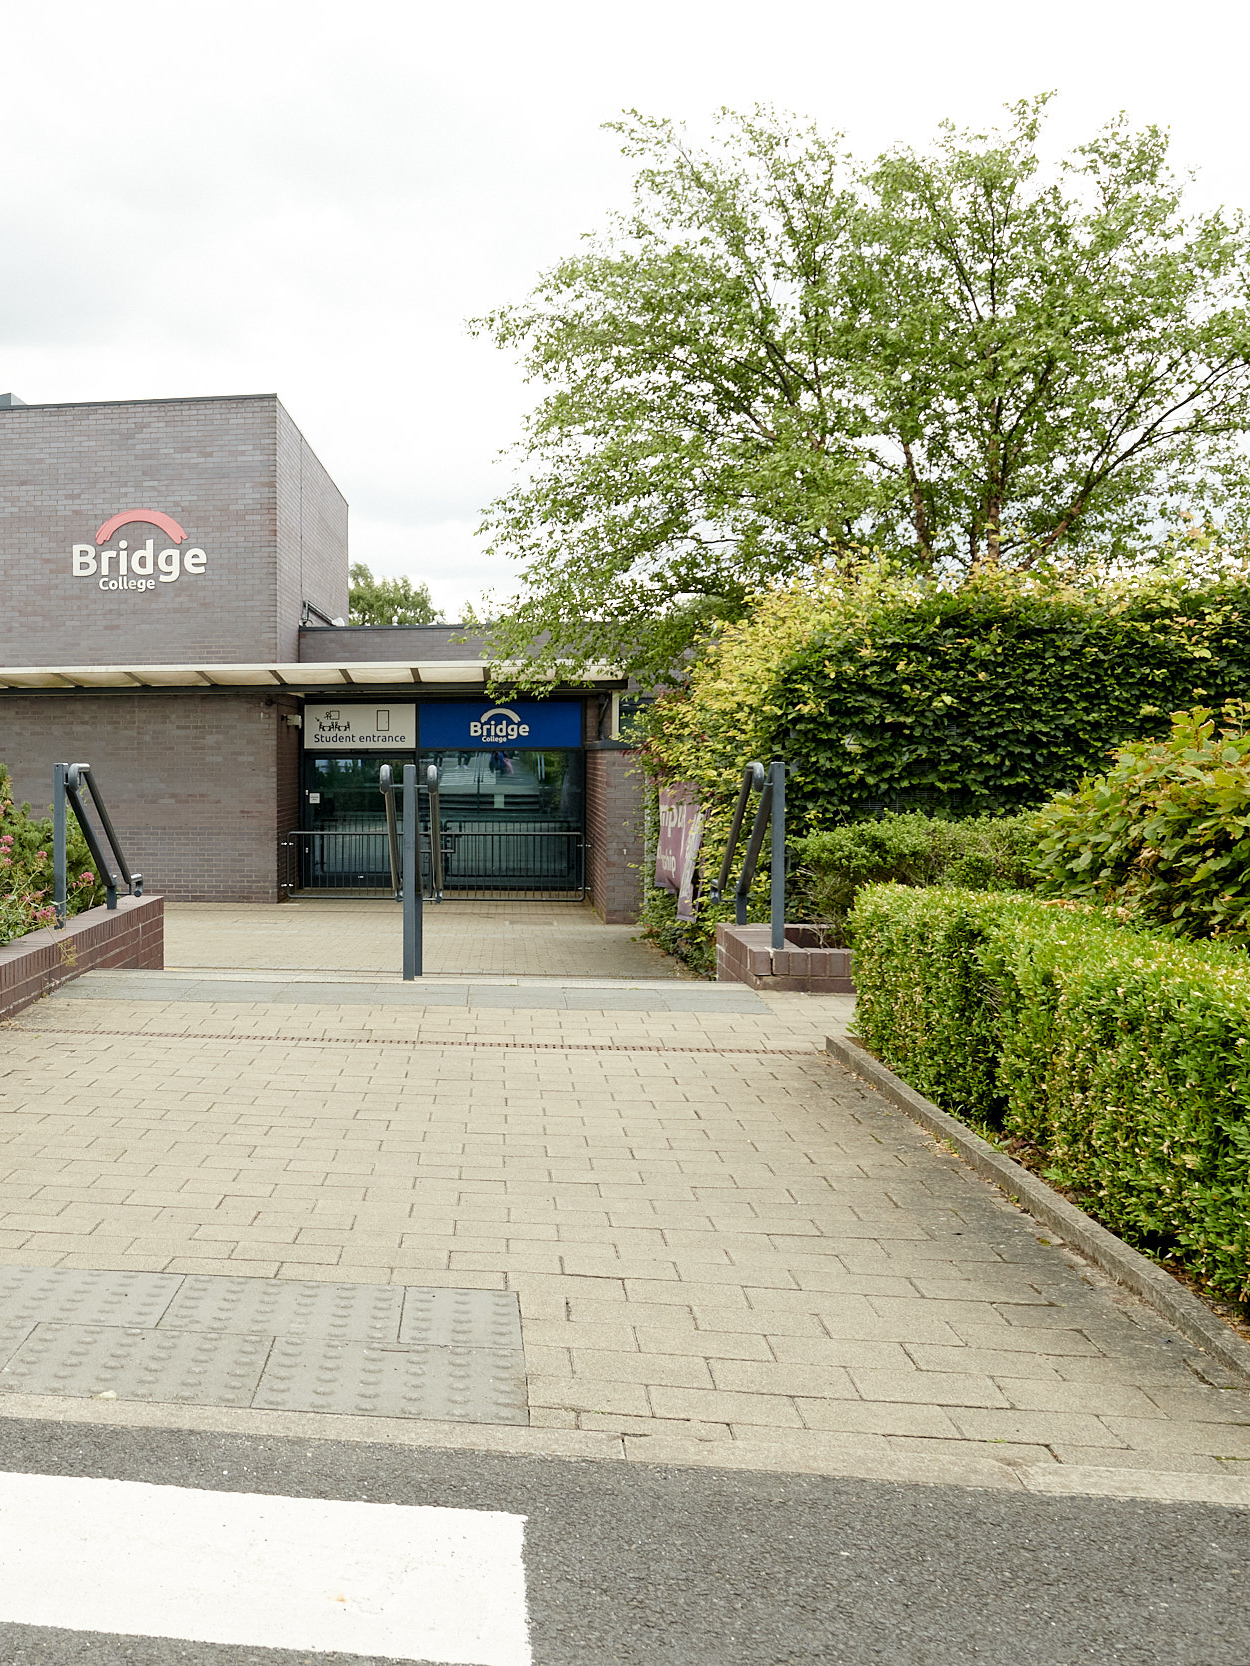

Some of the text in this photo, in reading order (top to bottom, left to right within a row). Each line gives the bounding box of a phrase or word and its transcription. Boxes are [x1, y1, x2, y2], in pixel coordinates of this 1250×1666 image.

[72, 539, 208, 583] Bridge
[99, 576, 156, 592] College
[314, 733, 406, 743] Student entrance
[470, 720, 530, 739] Bridge
